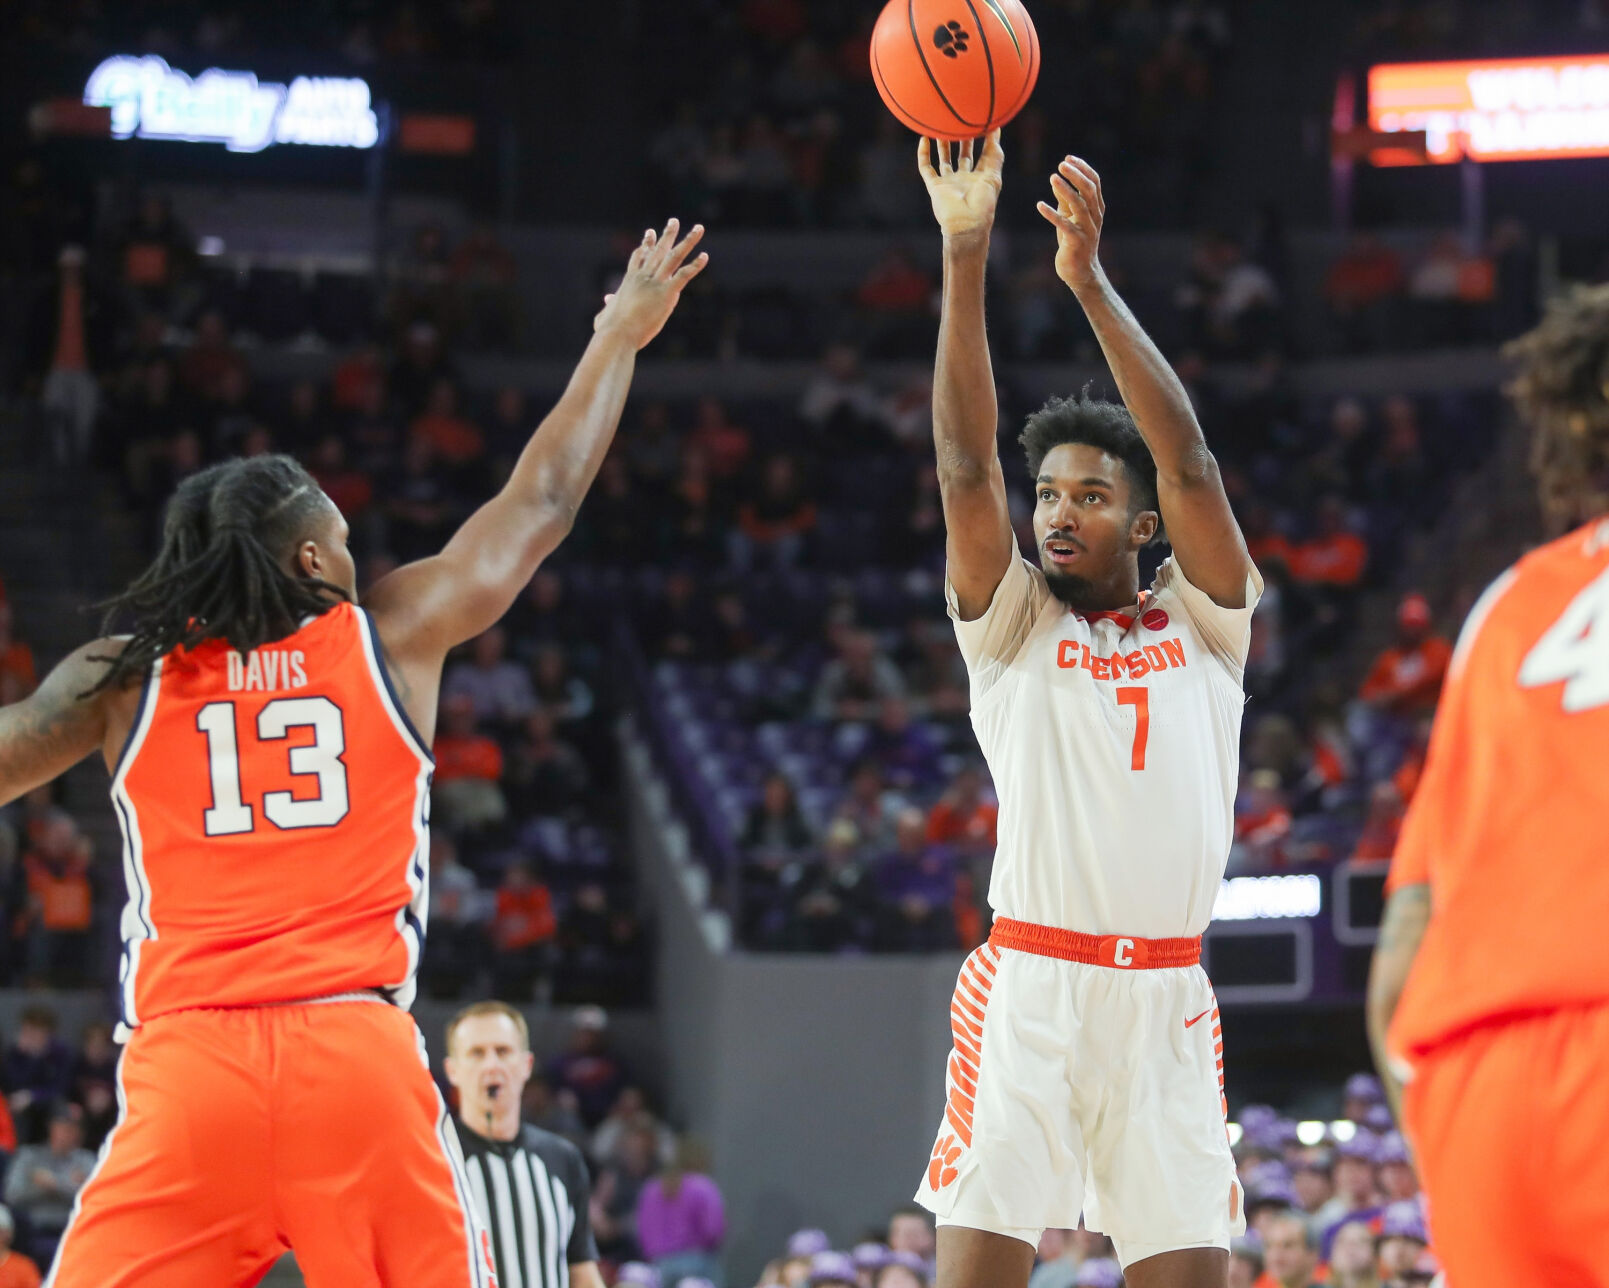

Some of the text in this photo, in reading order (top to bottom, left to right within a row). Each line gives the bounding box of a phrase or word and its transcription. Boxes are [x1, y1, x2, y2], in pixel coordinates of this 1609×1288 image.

[227, 650, 308, 692] DAVIS
[1057, 638, 1186, 680] CLEMSON
[1116, 687, 1149, 771] 7
[196, 695, 350, 837] 13
[1113, 938, 1134, 967] C
